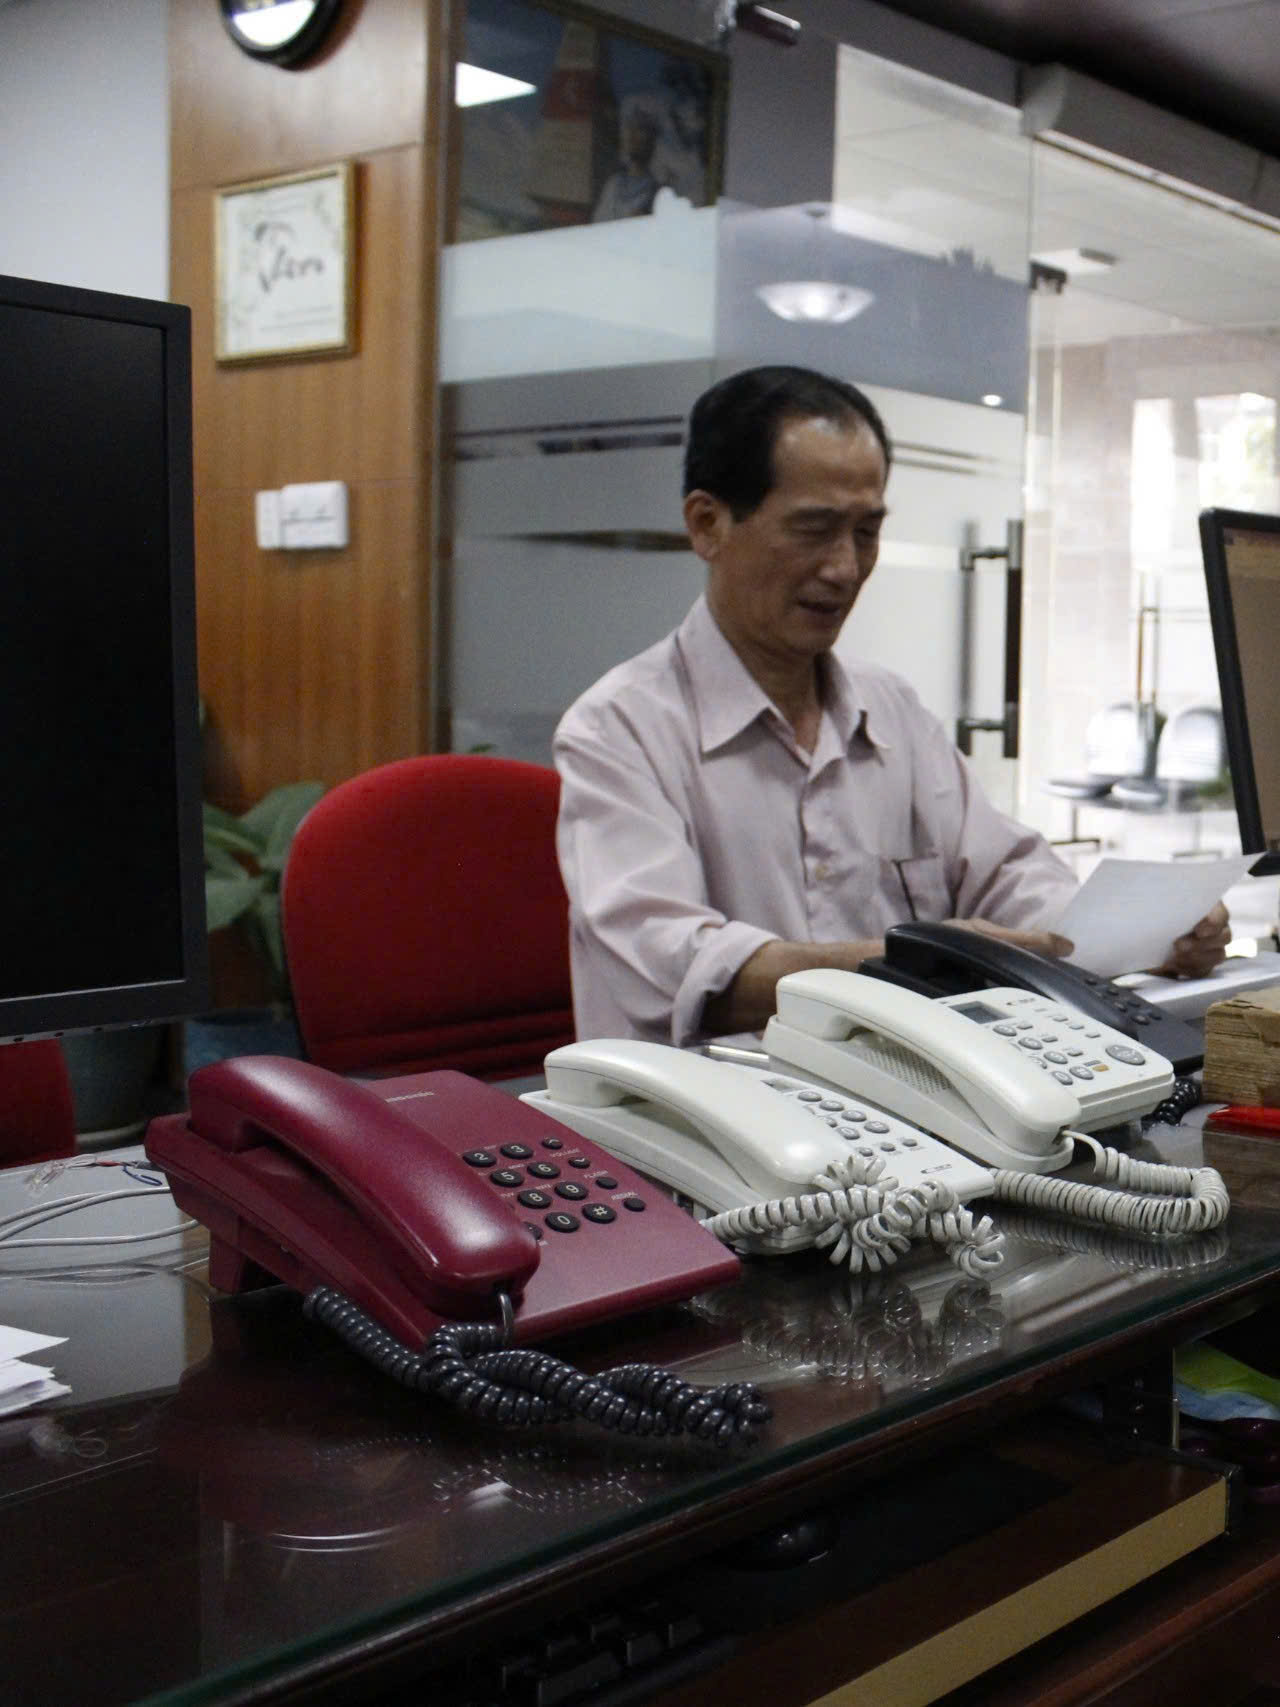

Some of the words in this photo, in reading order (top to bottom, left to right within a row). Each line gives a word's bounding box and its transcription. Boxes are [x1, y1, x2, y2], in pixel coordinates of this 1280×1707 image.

[474, 1152, 489, 1162] 2
[510, 1145, 525, 1153] 3
[501, 1171, 515, 1181] 5
[538, 1163, 552, 1173] 6
[529, 1192, 543, 1202] 8
[565, 1184, 580, 1194] 9
[557, 1215, 571, 1226] 0
